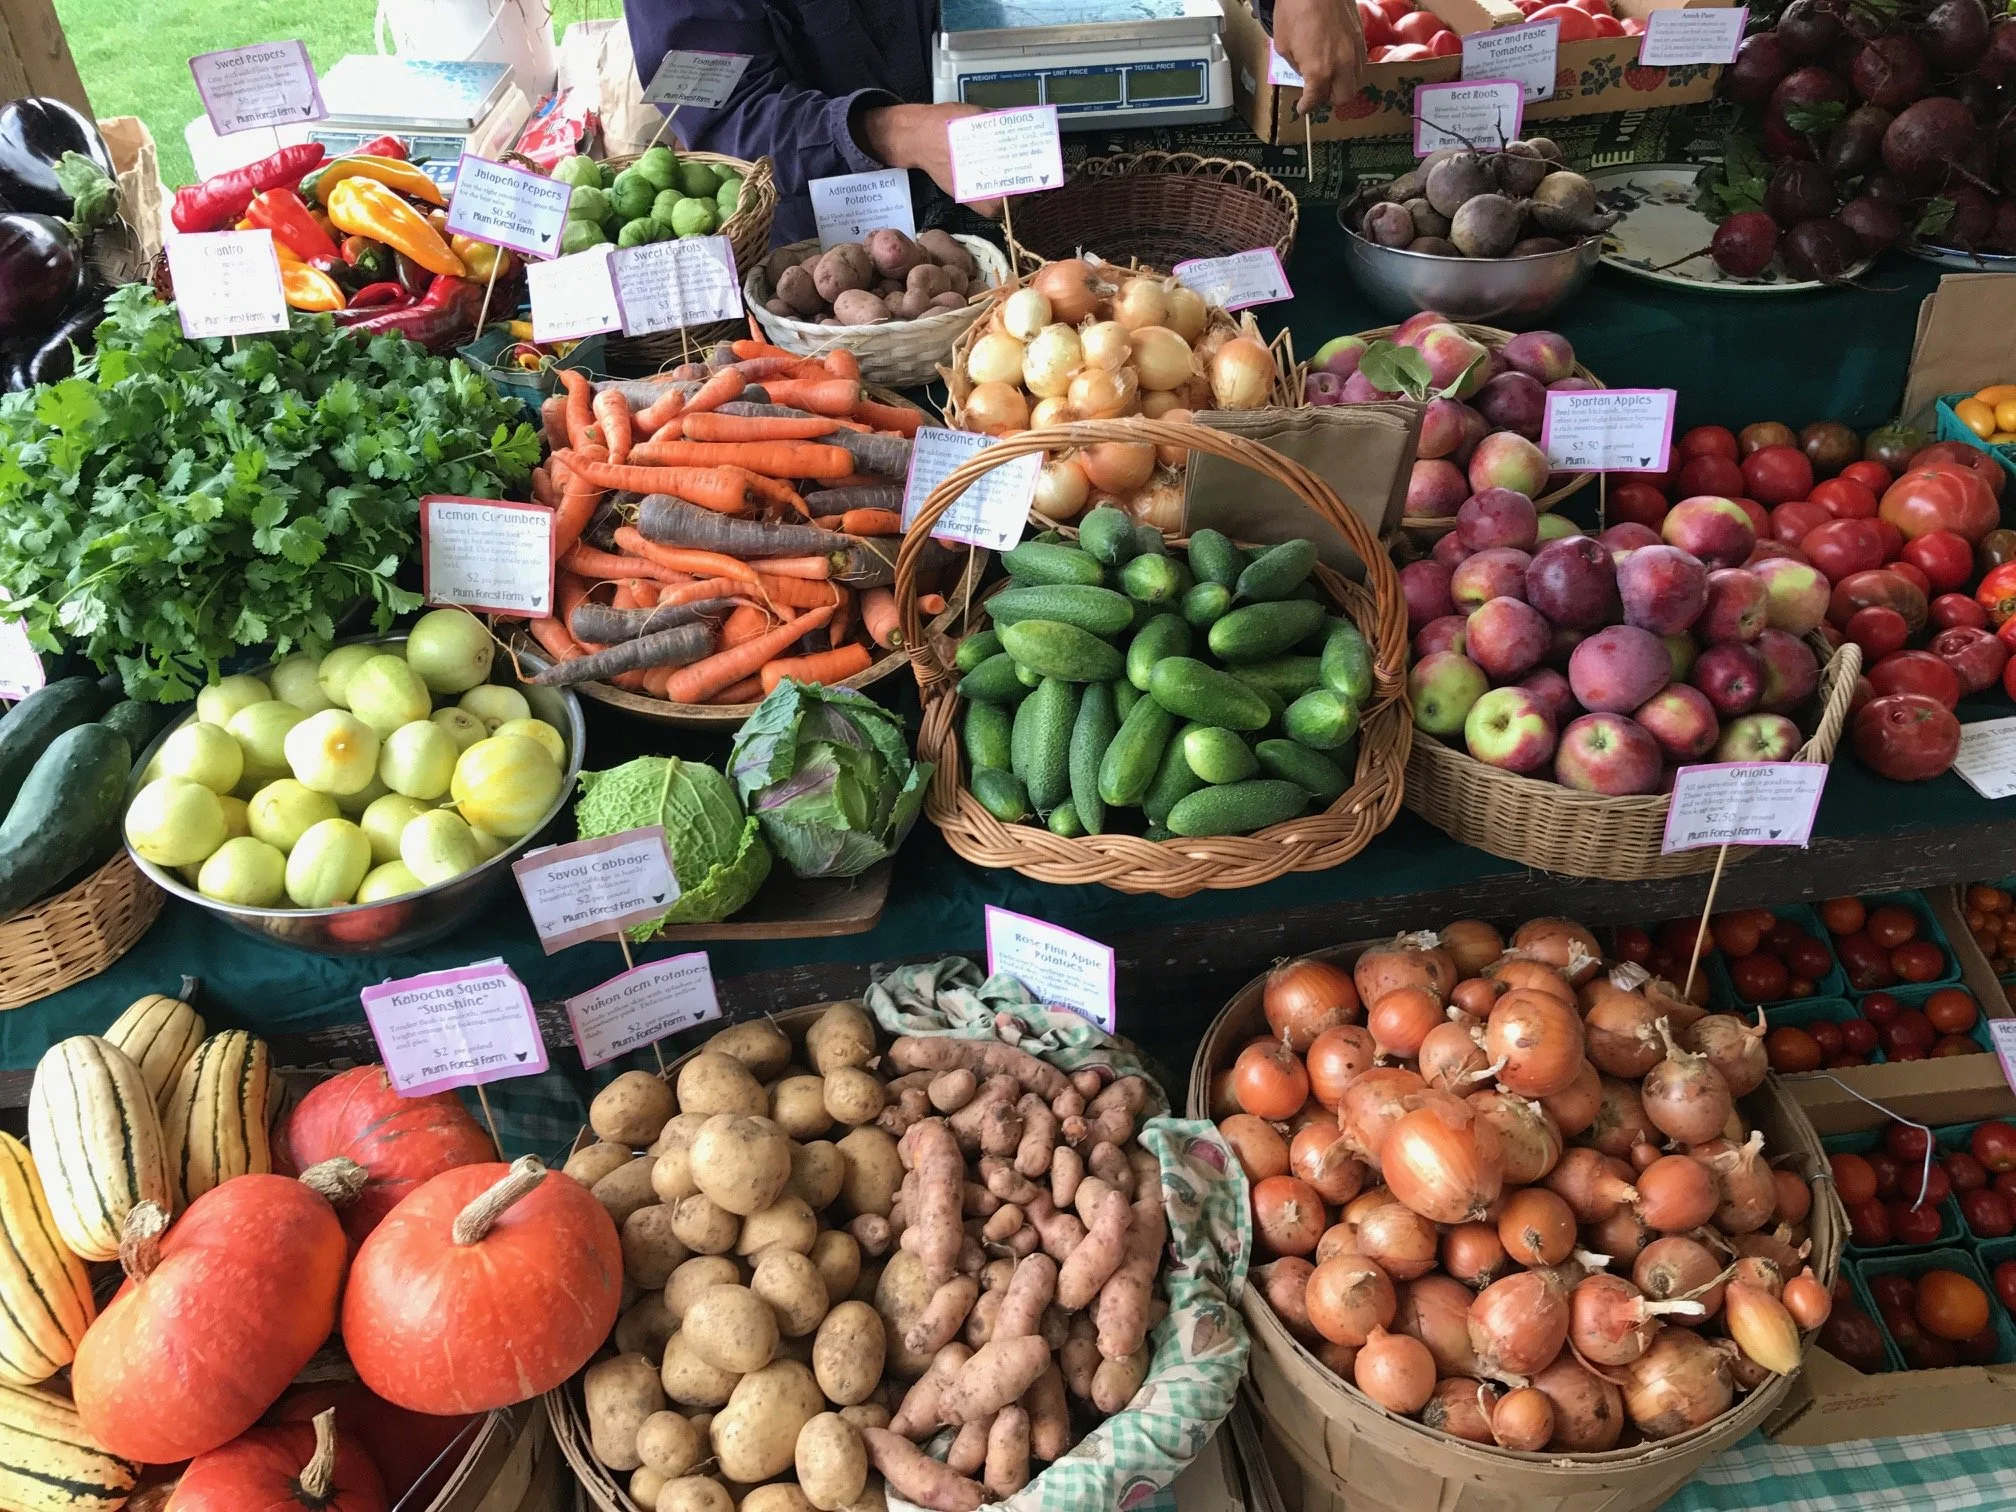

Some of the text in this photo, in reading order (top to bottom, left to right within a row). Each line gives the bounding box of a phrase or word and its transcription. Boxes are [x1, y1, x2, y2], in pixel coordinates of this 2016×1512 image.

[1477, 29, 1546, 50] Sauce and Paste
[1489, 43, 1533, 58] Tomatoes
[215, 49, 286, 70] Sweet Peppers
[1053, 68, 1088, 77] UNIT PRICE
[1134, 62, 1176, 71] TOTAL PRICE
[971, 74, 997, 82] WEIGHT
[663, 92, 711, 103] Plum Forest Farm
[1451, 90, 1499, 100] Beet Roots
[236, 105, 297, 124] Plum Forest Farm
[971, 113, 1034, 132] Sweet Onions
[1451, 123, 1462, 132] $3
[1439, 137, 1455, 146] Plum
[1477, 136, 1495, 144] Farm
[475, 168, 562, 201] Jalapeño Peppers
[829, 177, 896, 197] Adirondack Red
[976, 175, 1034, 191] Plum Forest Farm
[845, 193, 883, 206] Potatoes
[473, 211, 535, 236] Plum Forest Farm
[851, 226, 860, 236] $3
[204, 244, 244, 257] Cantro
[633, 243, 702, 262] Sweet Carrots
[1189, 259, 1215, 274] Fresh
[1247, 289, 1264, 299] Farm
[659, 300, 669, 310] $3
[246, 312, 265, 322] Farm
[689, 309, 708, 320] Farm
[1570, 395, 1652, 408] Spartan Apples
[921, 430, 973, 447] Awesome
[1572, 441, 1599, 452] $250
[1565, 456, 1586, 466] Plum
[438, 509, 478, 521] Lemon
[945, 509, 957, 519] $2
[948, 520, 992, 536] Forest Farm
[467, 572, 479, 583] $2
[452, 587, 524, 602] Plum Forest Farm
[1730, 768, 1774, 778] Onions
[1705, 812, 1736, 824] $2.50
[1687, 826, 1762, 841] Plum Forest Farm
[548, 852, 650, 883] Savoy Cabbage
[576, 894, 591, 906] $2
[562, 897, 645, 924] Plum Forest Farm
[1015, 933, 1103, 970] Rose Finn Apple
[1035, 950, 1084, 973] Potatoes
[391, 978, 507, 1007] Kabocha Squash
[581, 965, 708, 1015] Yukon Gem Potatoes
[1068, 1002, 1089, 1017] Farm
[612, 1015, 687, 1050] Plum Forest Farm
[627, 1021, 642, 1034] $2
[433, 1046, 449, 1058] $2
[422, 1051, 507, 1077] Plum Forest Farm
